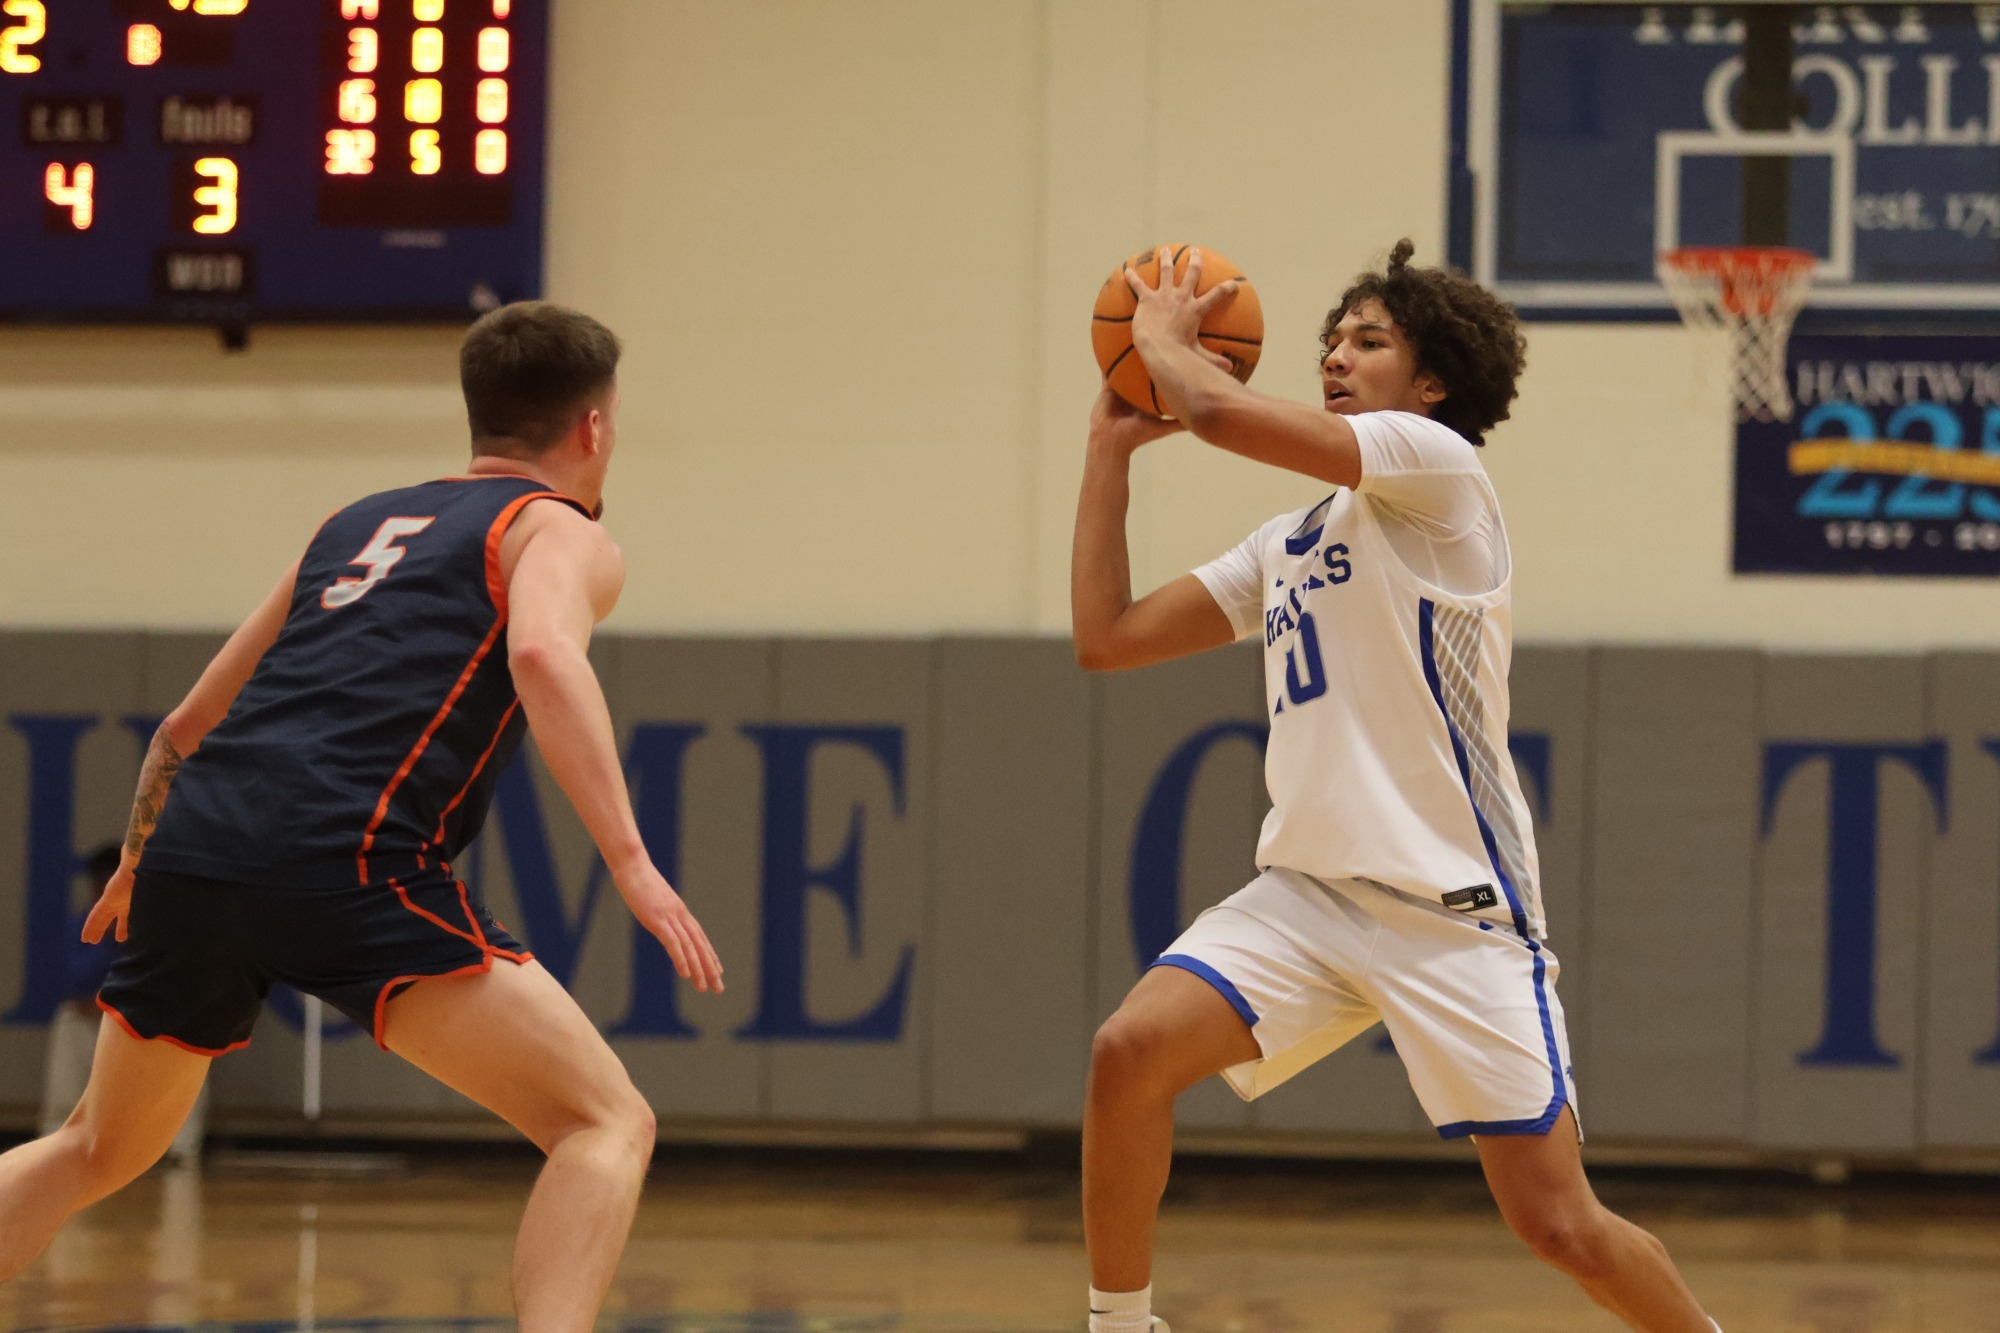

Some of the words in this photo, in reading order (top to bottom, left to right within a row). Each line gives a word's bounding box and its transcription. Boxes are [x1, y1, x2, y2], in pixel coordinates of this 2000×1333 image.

[348, 28, 378, 72] 3
[1702, 54, 2000, 146] COLL
[411, 129, 441, 174] 5
[46, 162, 94, 230] 4
[193, 157, 238, 234] 3
[320, 516, 437, 610] 5
[1273, 611, 1328, 715] 0
[4, 710, 917, 1046] HME
[1760, 736, 2000, 1070] T
[1476, 890, 1492, 902] XL
